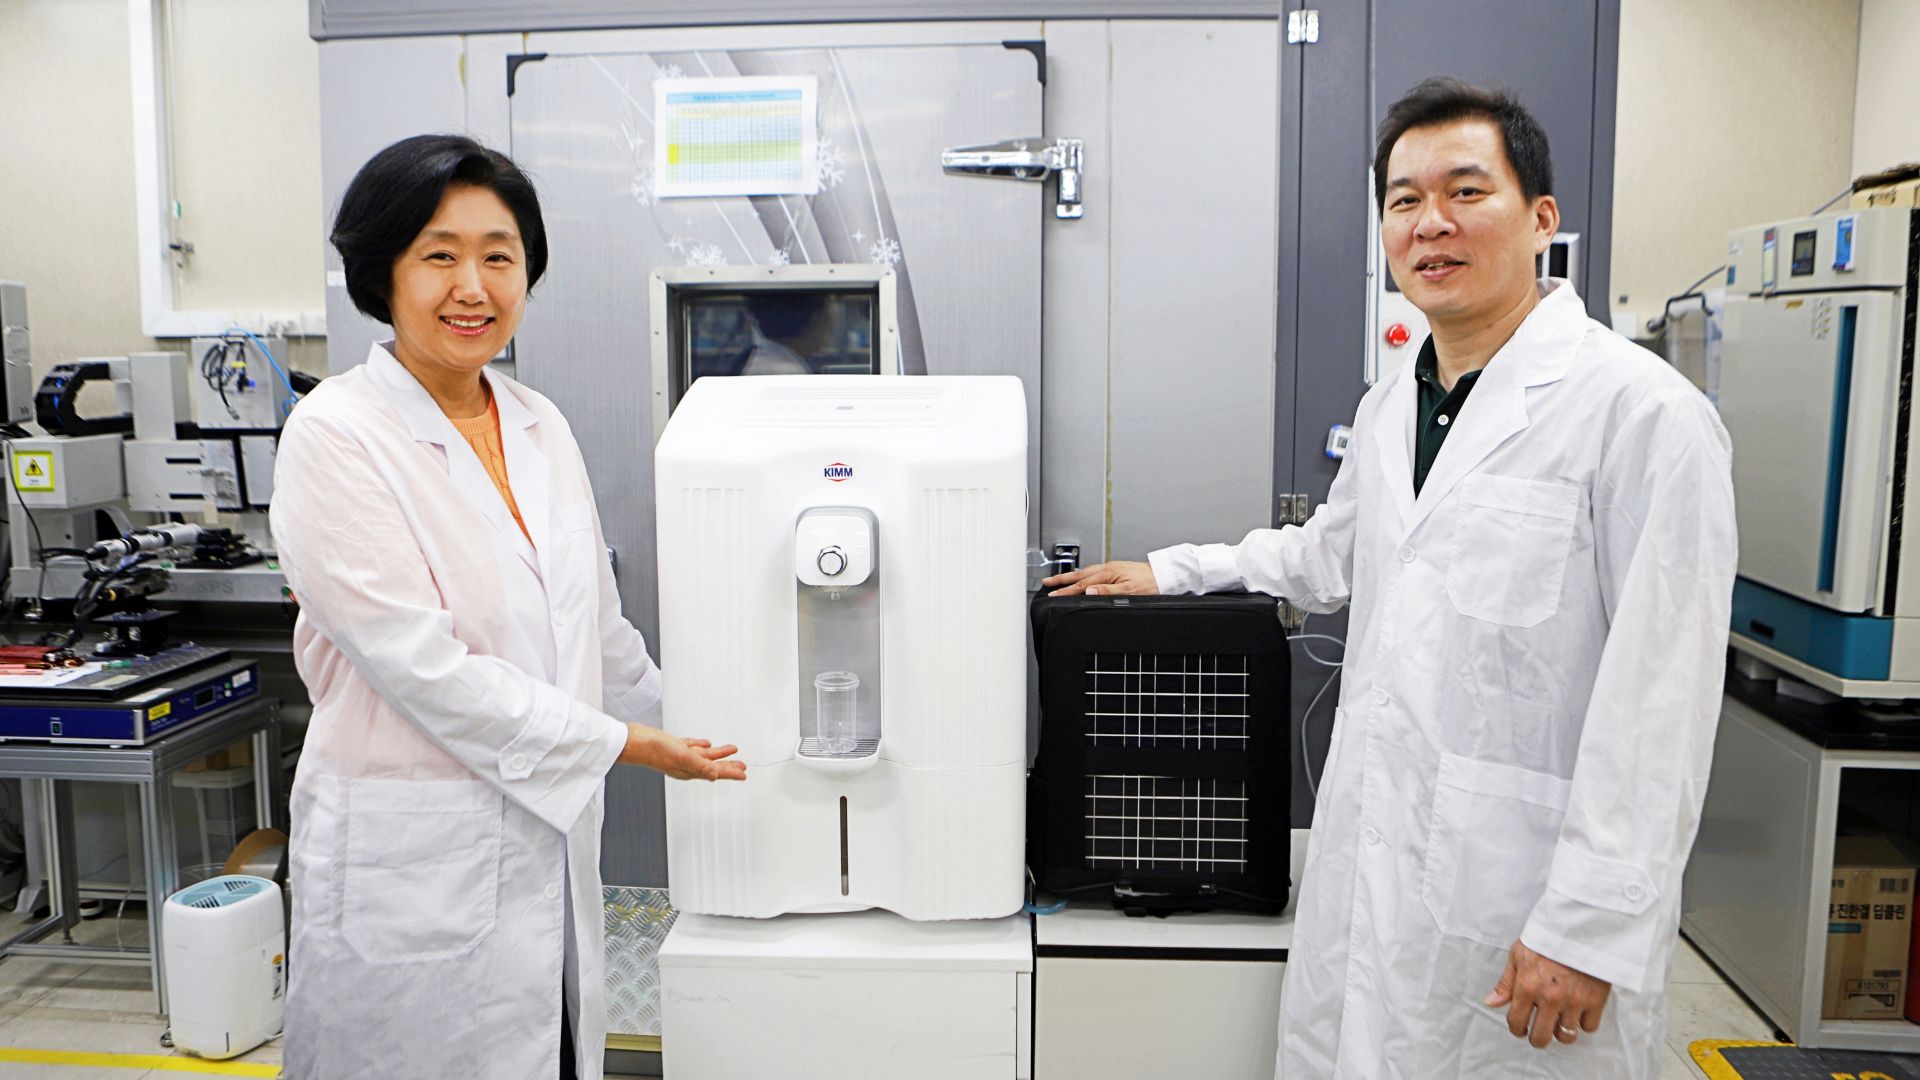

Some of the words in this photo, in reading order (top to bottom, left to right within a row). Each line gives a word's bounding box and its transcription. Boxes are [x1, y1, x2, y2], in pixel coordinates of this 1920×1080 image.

[824, 467, 853, 478] KIMM
[197, 579, 234, 594] SPS
[1873, 903, 1905, 920] 딥클린
